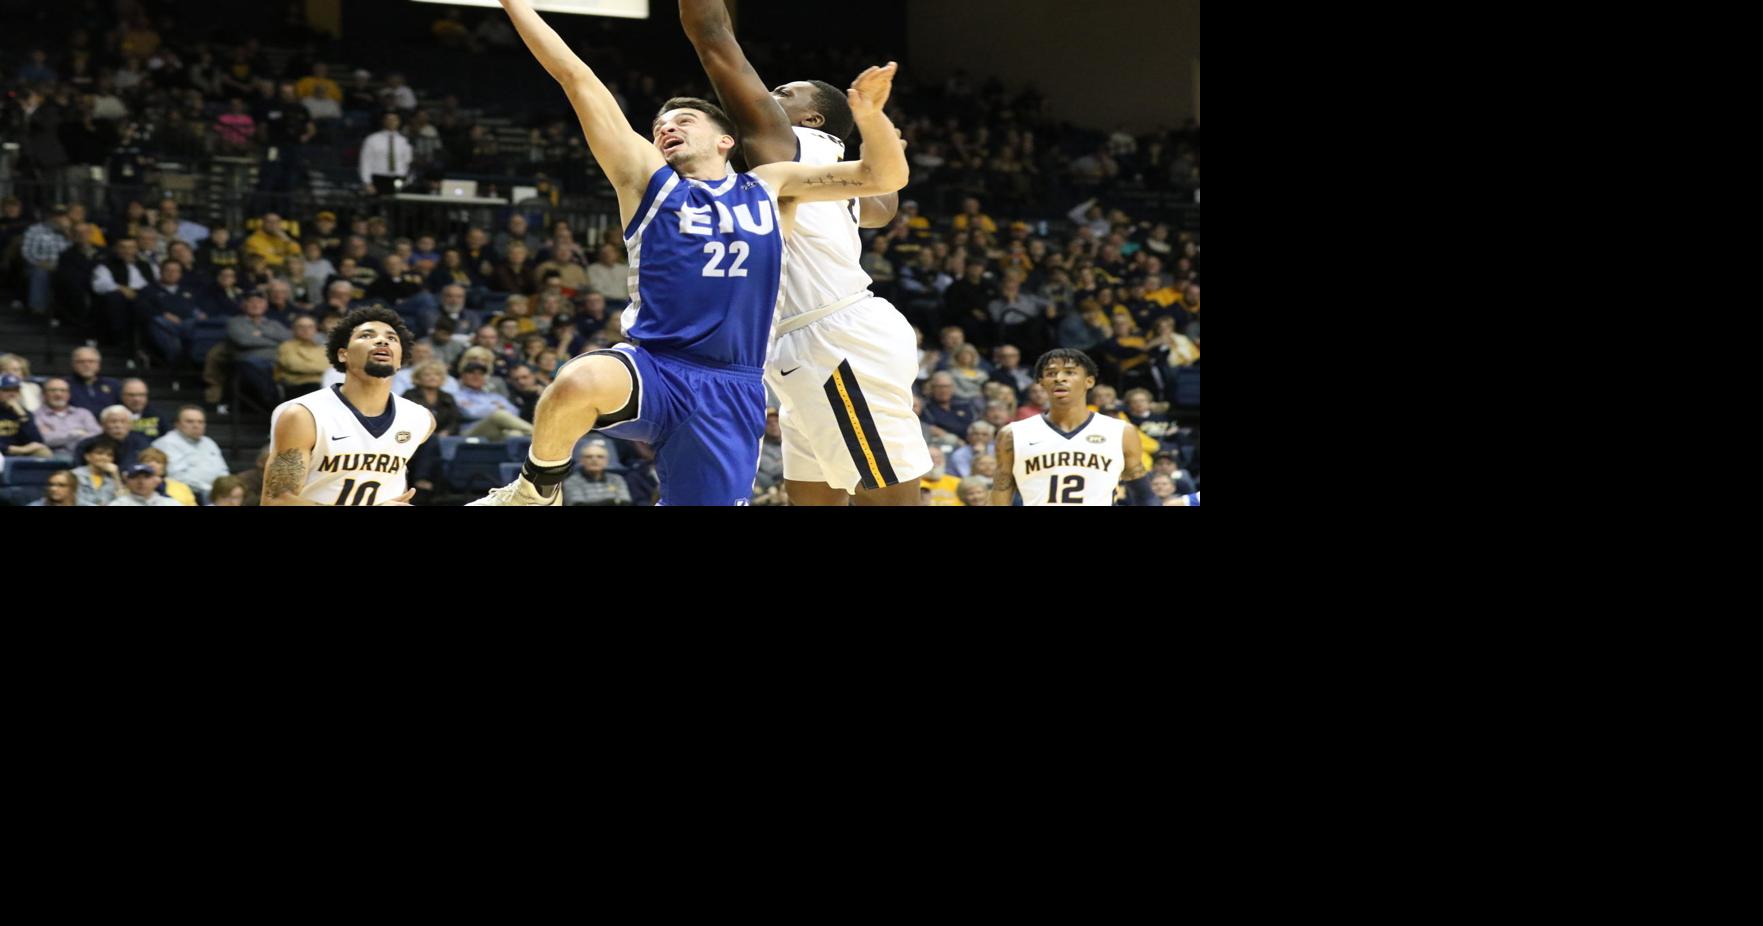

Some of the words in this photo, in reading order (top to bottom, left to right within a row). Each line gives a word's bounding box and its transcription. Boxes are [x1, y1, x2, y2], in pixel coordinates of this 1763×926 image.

[674, 200, 774, 236] EIU
[702, 240, 750, 278] 22
[1025, 451, 1112, 475] MURRAY
[334, 478, 382, 506] 10
[1047, 474, 1085, 504] 12
